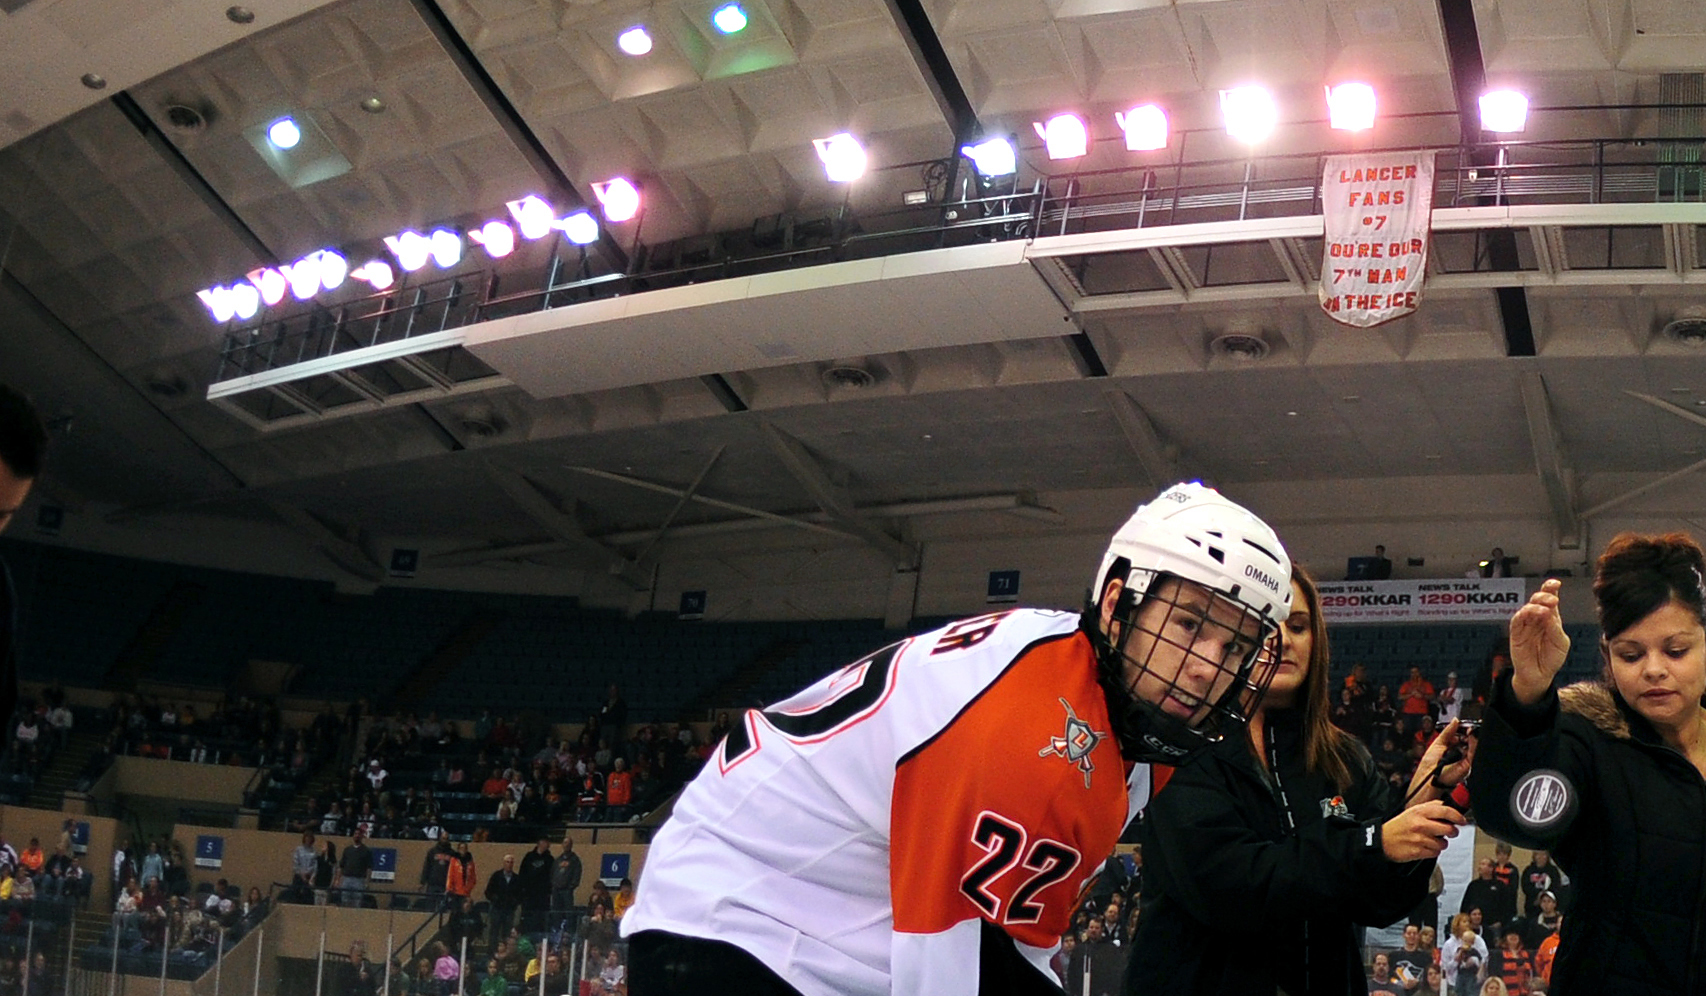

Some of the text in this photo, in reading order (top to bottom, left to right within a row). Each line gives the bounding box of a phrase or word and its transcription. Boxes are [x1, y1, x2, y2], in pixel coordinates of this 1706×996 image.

[1340, 165, 1417, 183] LANCER
[1349, 190, 1405, 207] FANS
[1362, 216, 1387, 231] #7
[1389, 238, 1422, 258] OUR
[1367, 266, 1407, 284] MAN
[1344, 294, 1383, 310] THE
[1386, 292, 1417, 309] ICE
[997, 578, 1009, 589] 71
[1244, 563, 1281, 595] OMAHA
[1453, 583, 1481, 591] TALK
[1319, 594, 1411, 607] 290KKAR
[1419, 592, 1519, 605] 1290KKAR
[205, 841, 214, 853] 5
[379, 853, 387, 865] 5
[611, 860, 619, 872] 6
[959, 809, 1081, 925] 22
